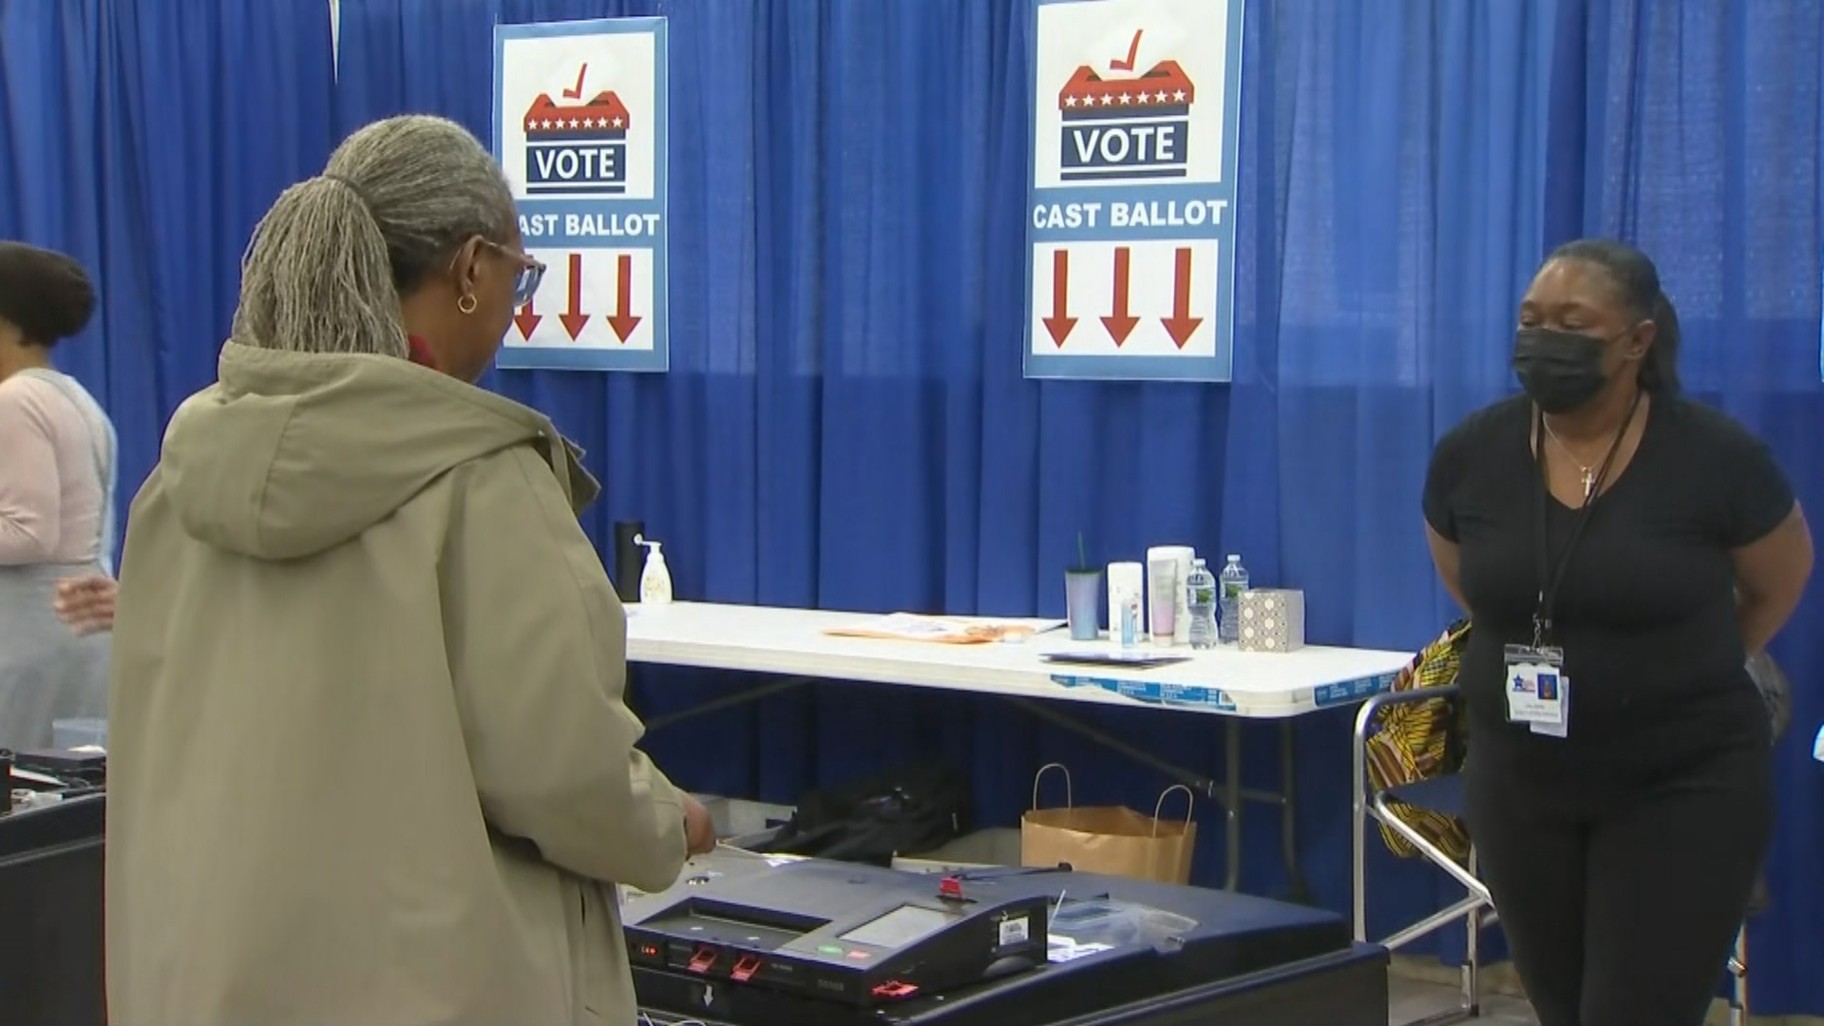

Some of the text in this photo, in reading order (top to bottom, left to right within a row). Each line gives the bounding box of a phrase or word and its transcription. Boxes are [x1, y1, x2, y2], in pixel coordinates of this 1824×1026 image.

[1073, 126, 1175, 163] VOTE
[535, 148, 615, 179] VOTE
[518, 213, 661, 236] AST BALLOT
[1033, 200, 1228, 229] CAST BALLOT
